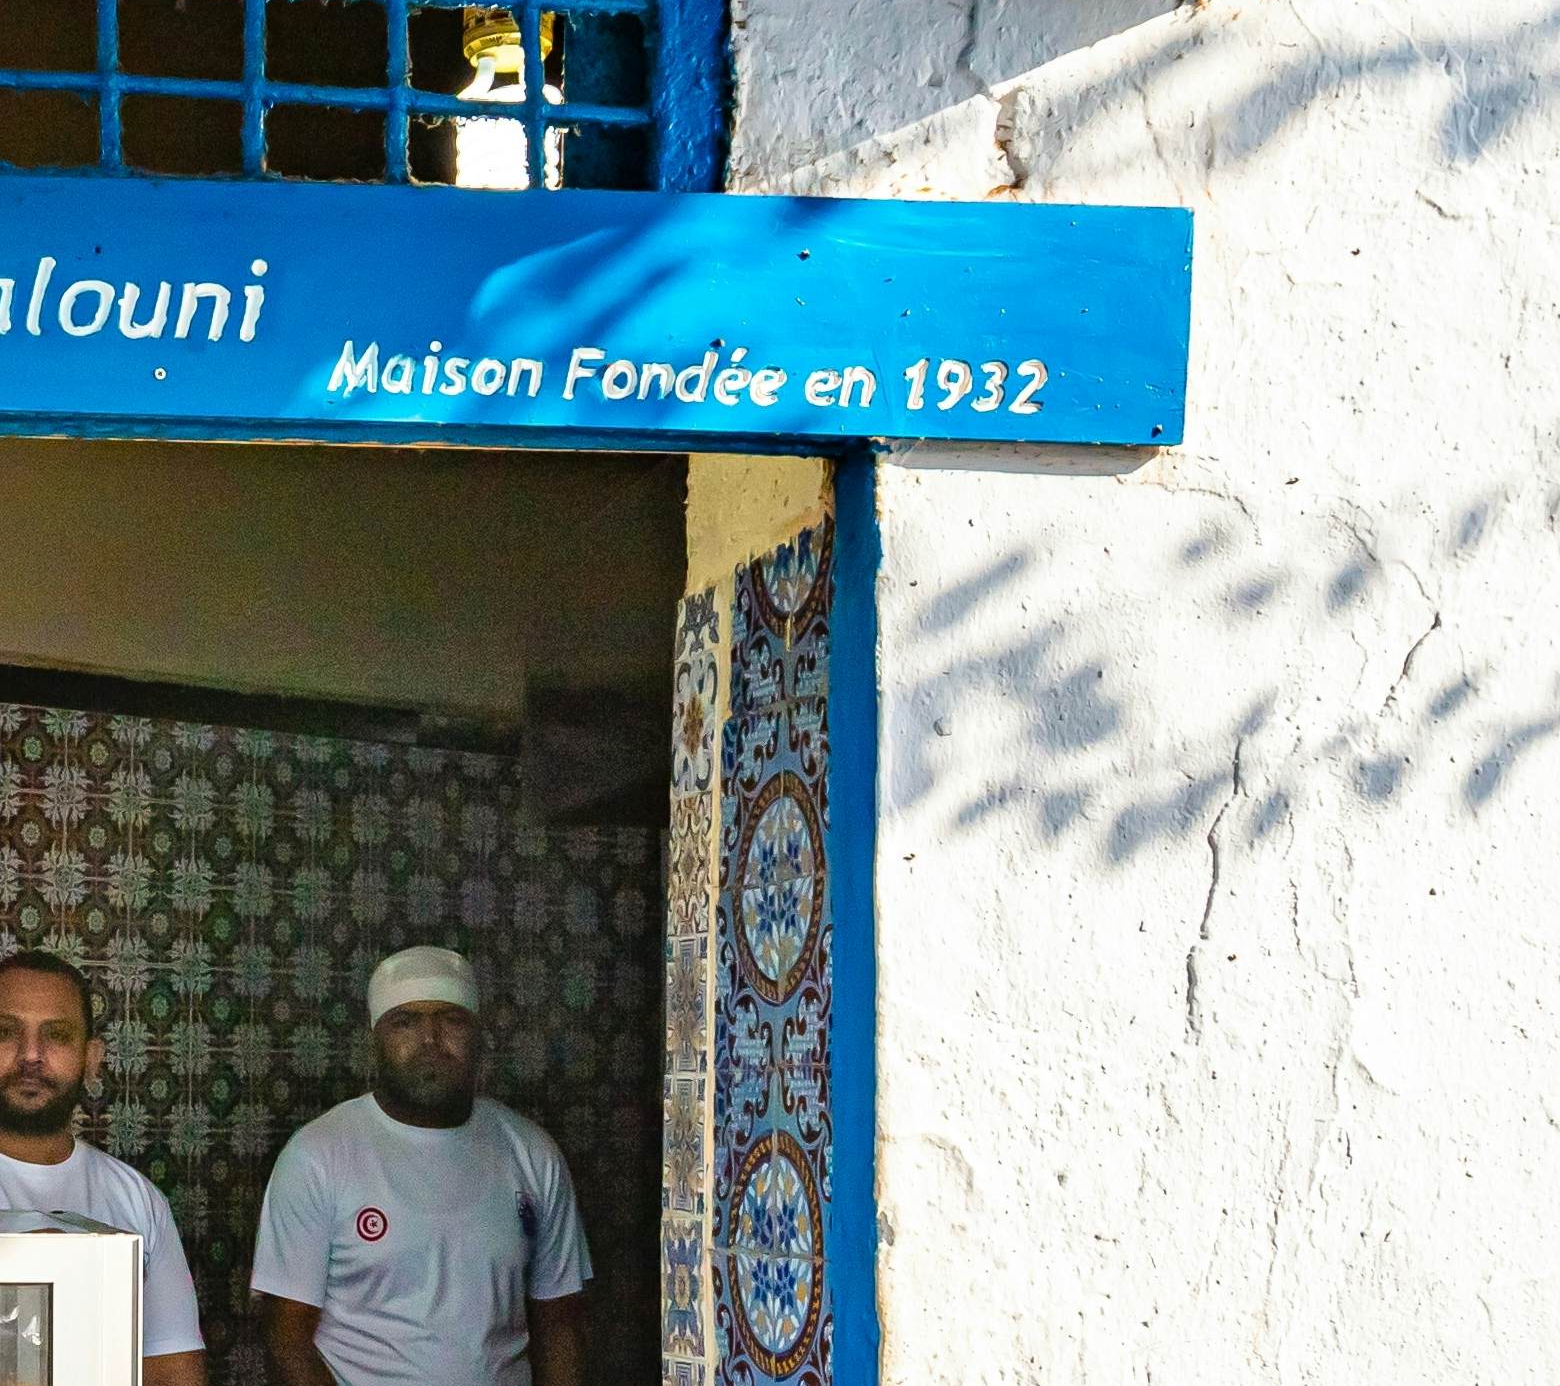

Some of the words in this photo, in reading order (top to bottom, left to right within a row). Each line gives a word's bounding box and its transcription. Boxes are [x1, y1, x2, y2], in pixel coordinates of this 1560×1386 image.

[326, 340, 543, 397] Maison
[562, 345, 788, 408] Fondée
[804, 364, 877, 409] en
[904, 358, 1049, 414] 1932
